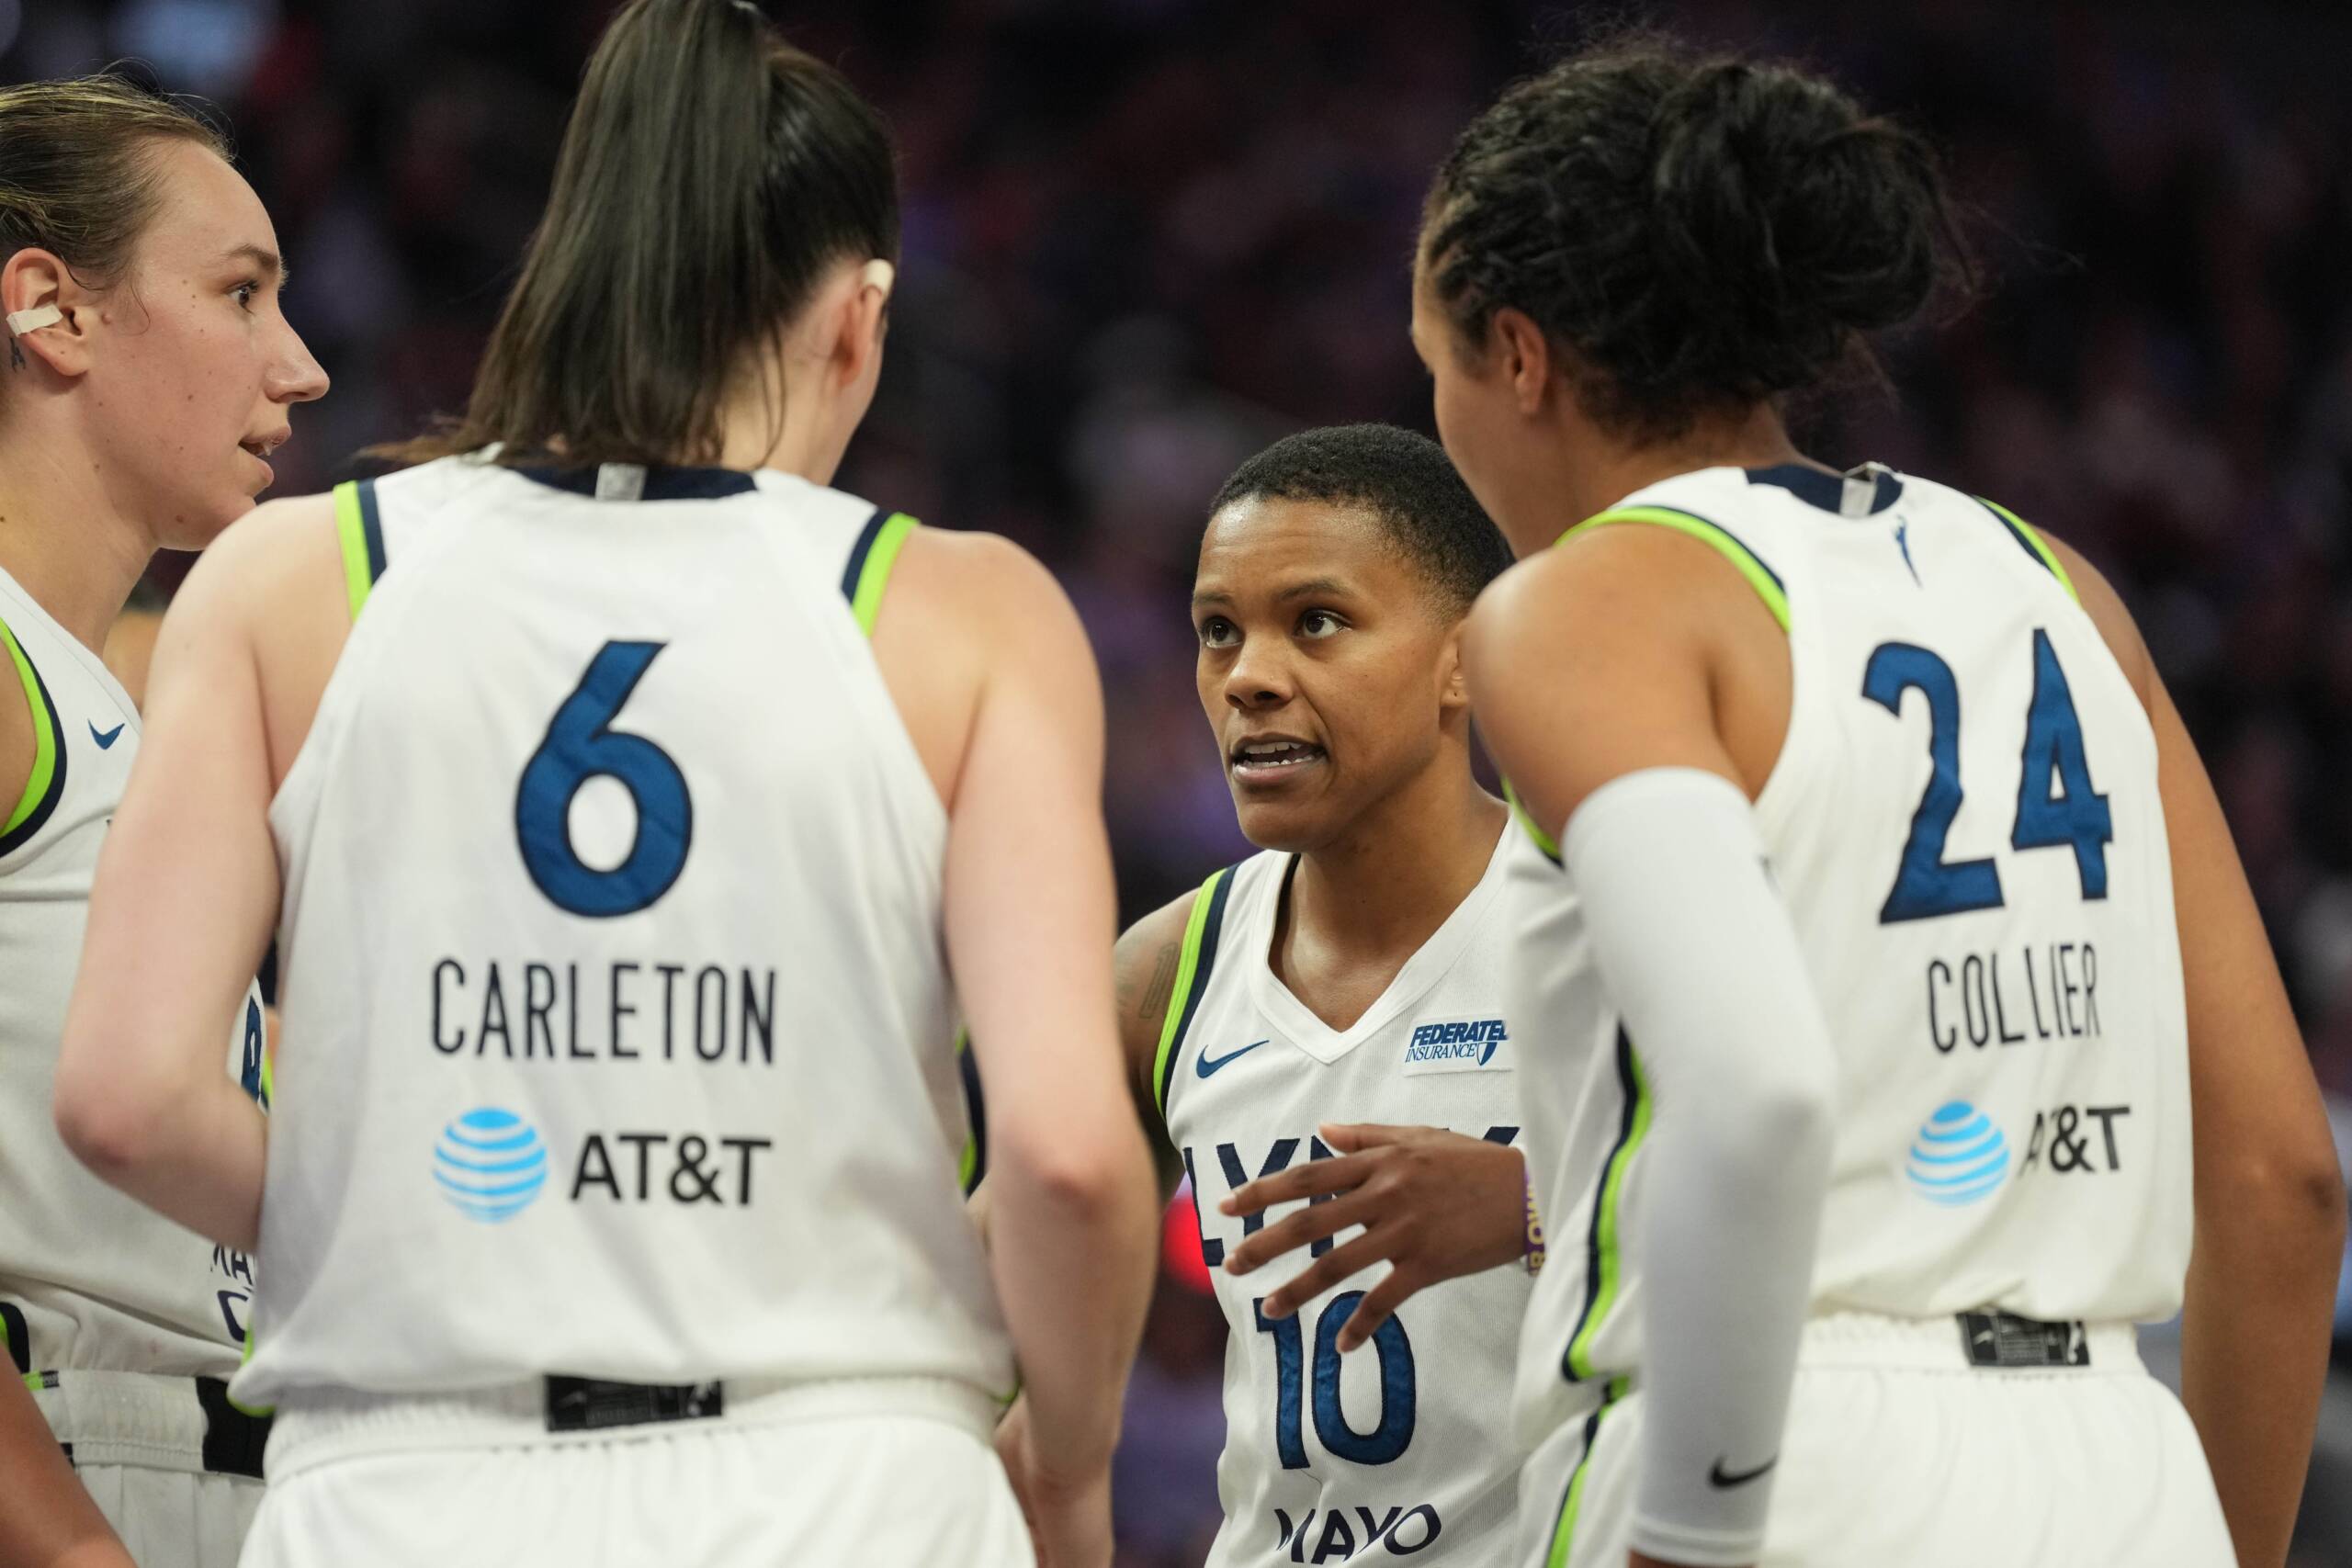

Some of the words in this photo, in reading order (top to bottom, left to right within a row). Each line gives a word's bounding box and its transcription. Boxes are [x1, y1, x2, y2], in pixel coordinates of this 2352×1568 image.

[514, 640, 694, 919] 6
[1861, 627, 2114, 925] 24
[433, 957, 775, 1065] CARLETON
[1405, 1043, 1478, 1063] INSURANCE
[1928, 942, 2101, 1055] COLLIER
[570, 1134, 773, 1205] AT&T
[1252, 1290, 1416, 1470] 10
[1273, 1504, 1442, 1565] MAYO
